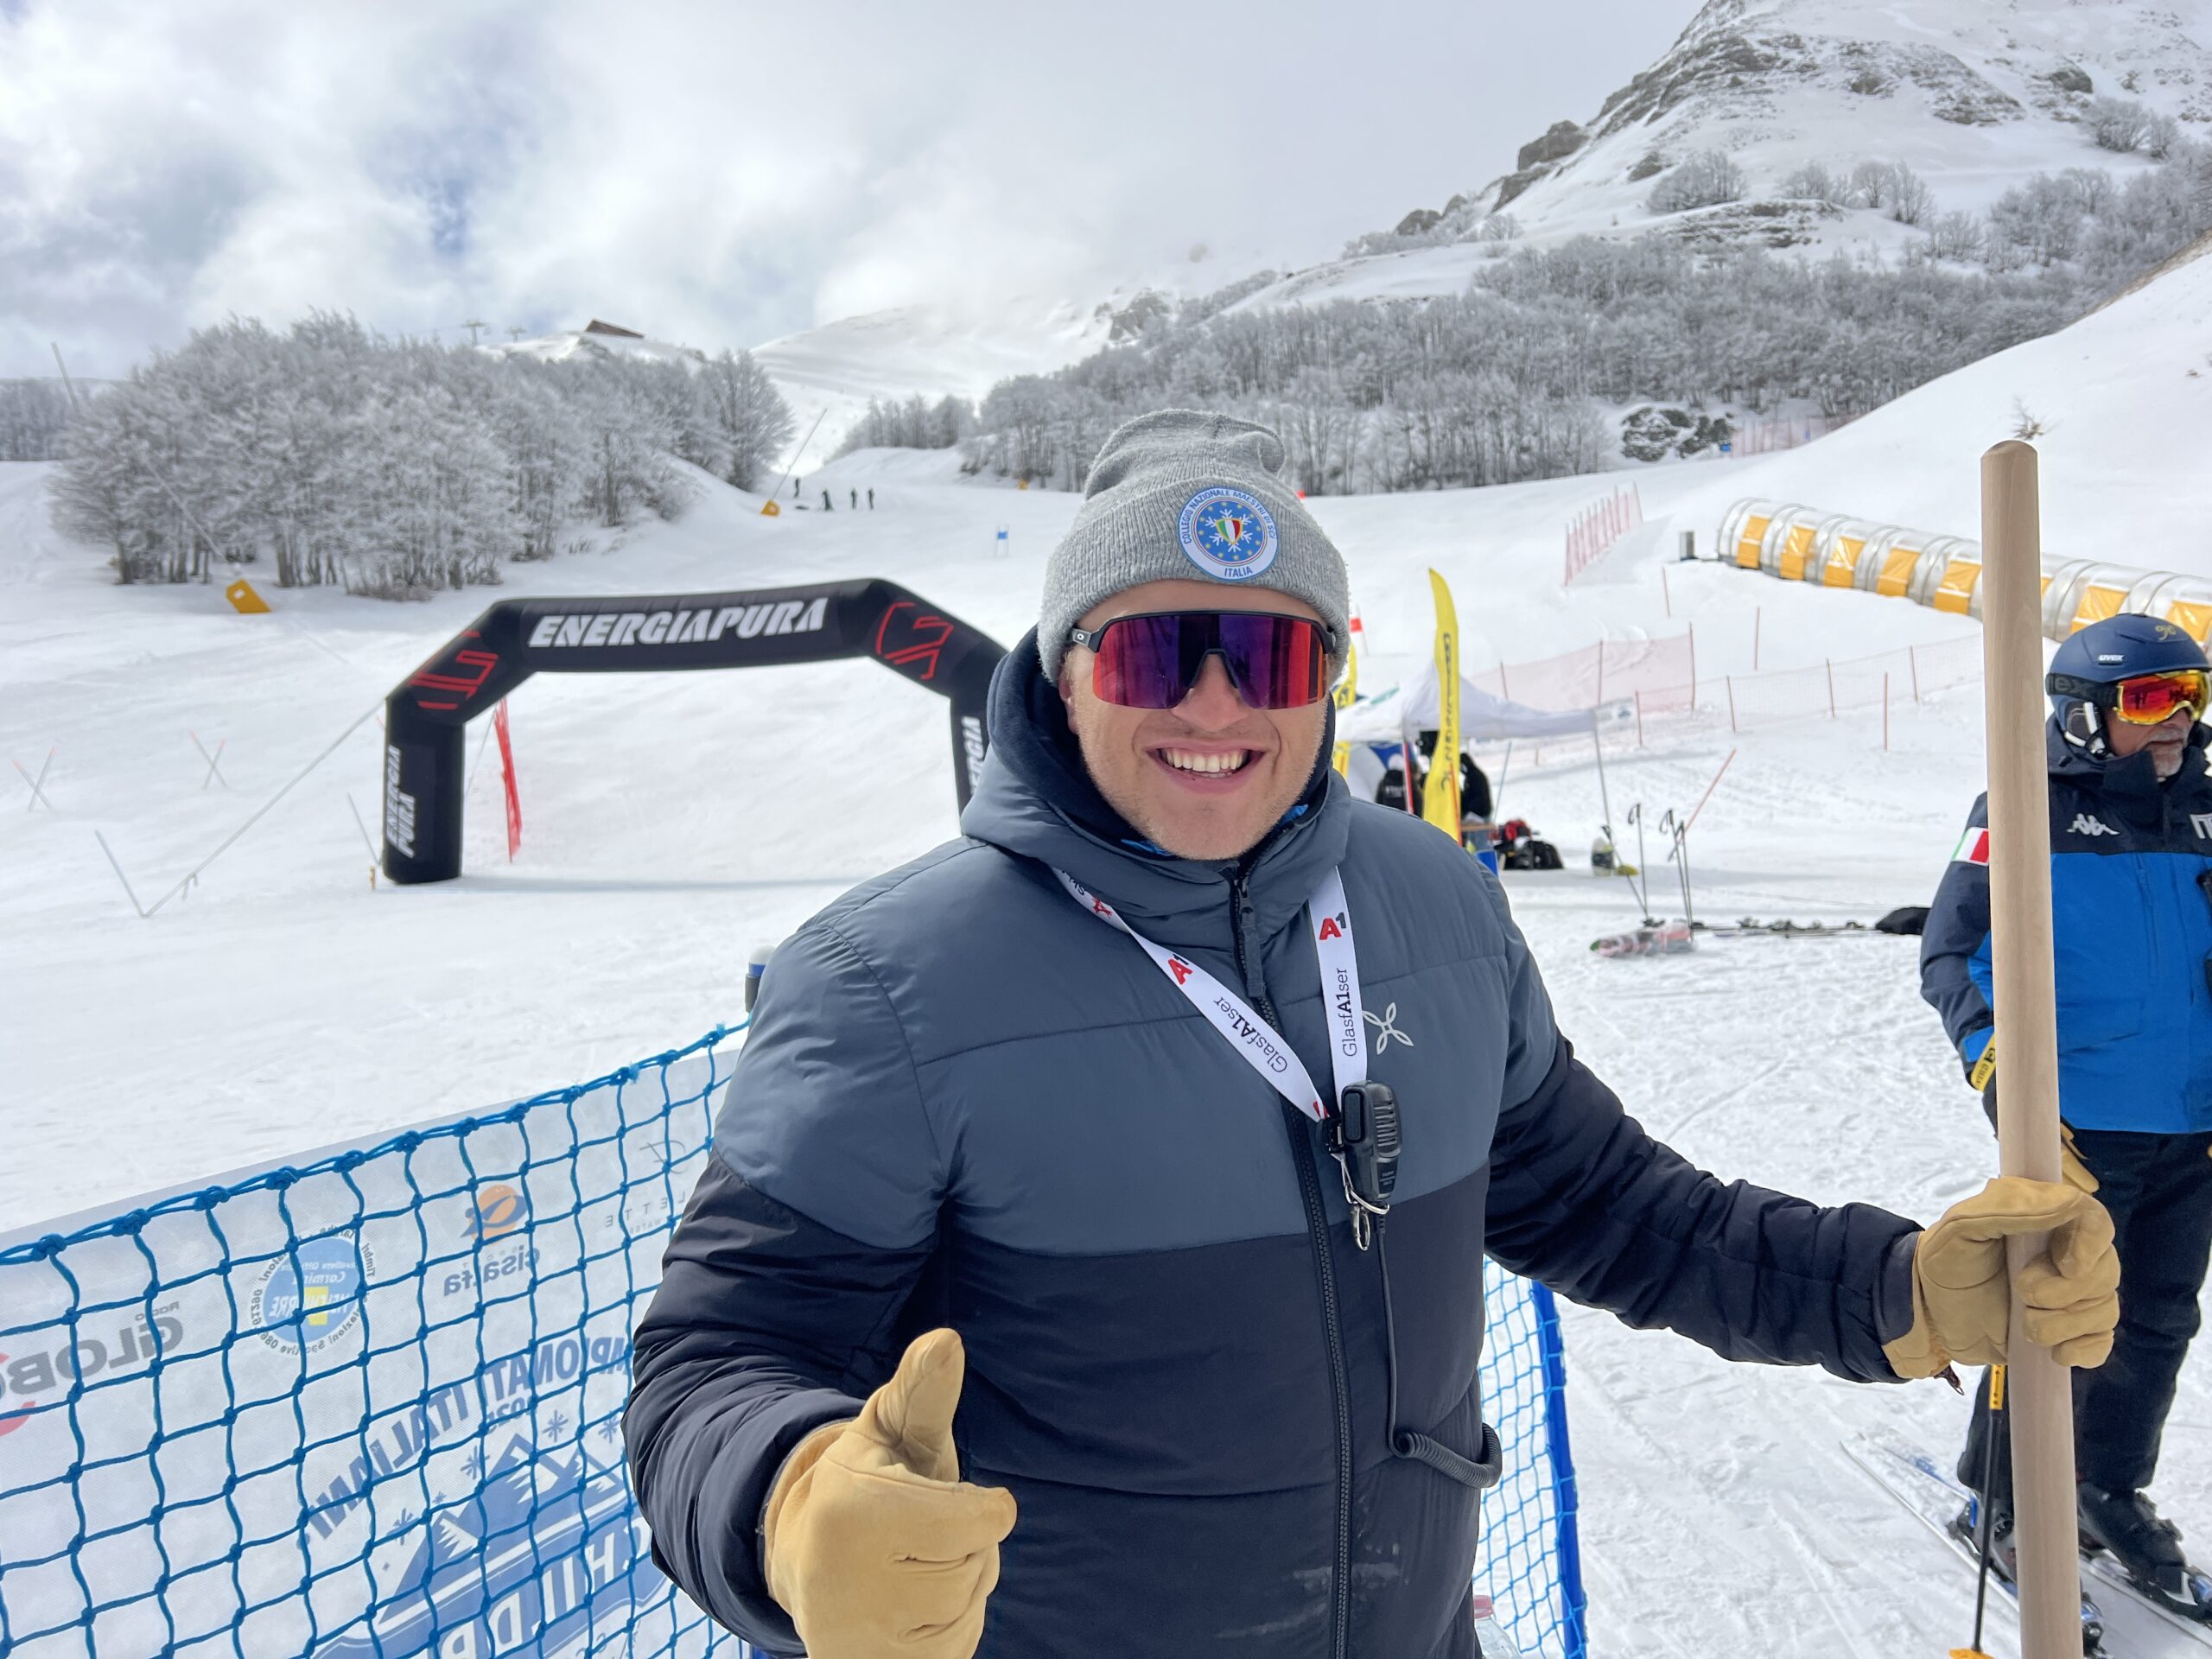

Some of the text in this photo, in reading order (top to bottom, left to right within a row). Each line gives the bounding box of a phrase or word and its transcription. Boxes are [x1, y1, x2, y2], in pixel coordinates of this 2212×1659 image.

[1180, 509, 1193, 544] COLLEGIO
[1190, 489, 1230, 510] NAZIONALE
[1232, 492, 1265, 516] MAESTRI
[1267, 523, 1276, 539] SCI
[1224, 566, 1254, 578] ITALIA
[528, 597, 828, 649] ENERGIAPURA
[386, 745, 402, 847] ENERGIA
[397, 791, 416, 859] PURA
[1319, 912, 1347, 940] A1
[1167, 953, 1192, 985] A1
[1213, 996, 1288, 1073] GlasfA1ser
[1335, 967, 1357, 1057] GlasfA1ser
